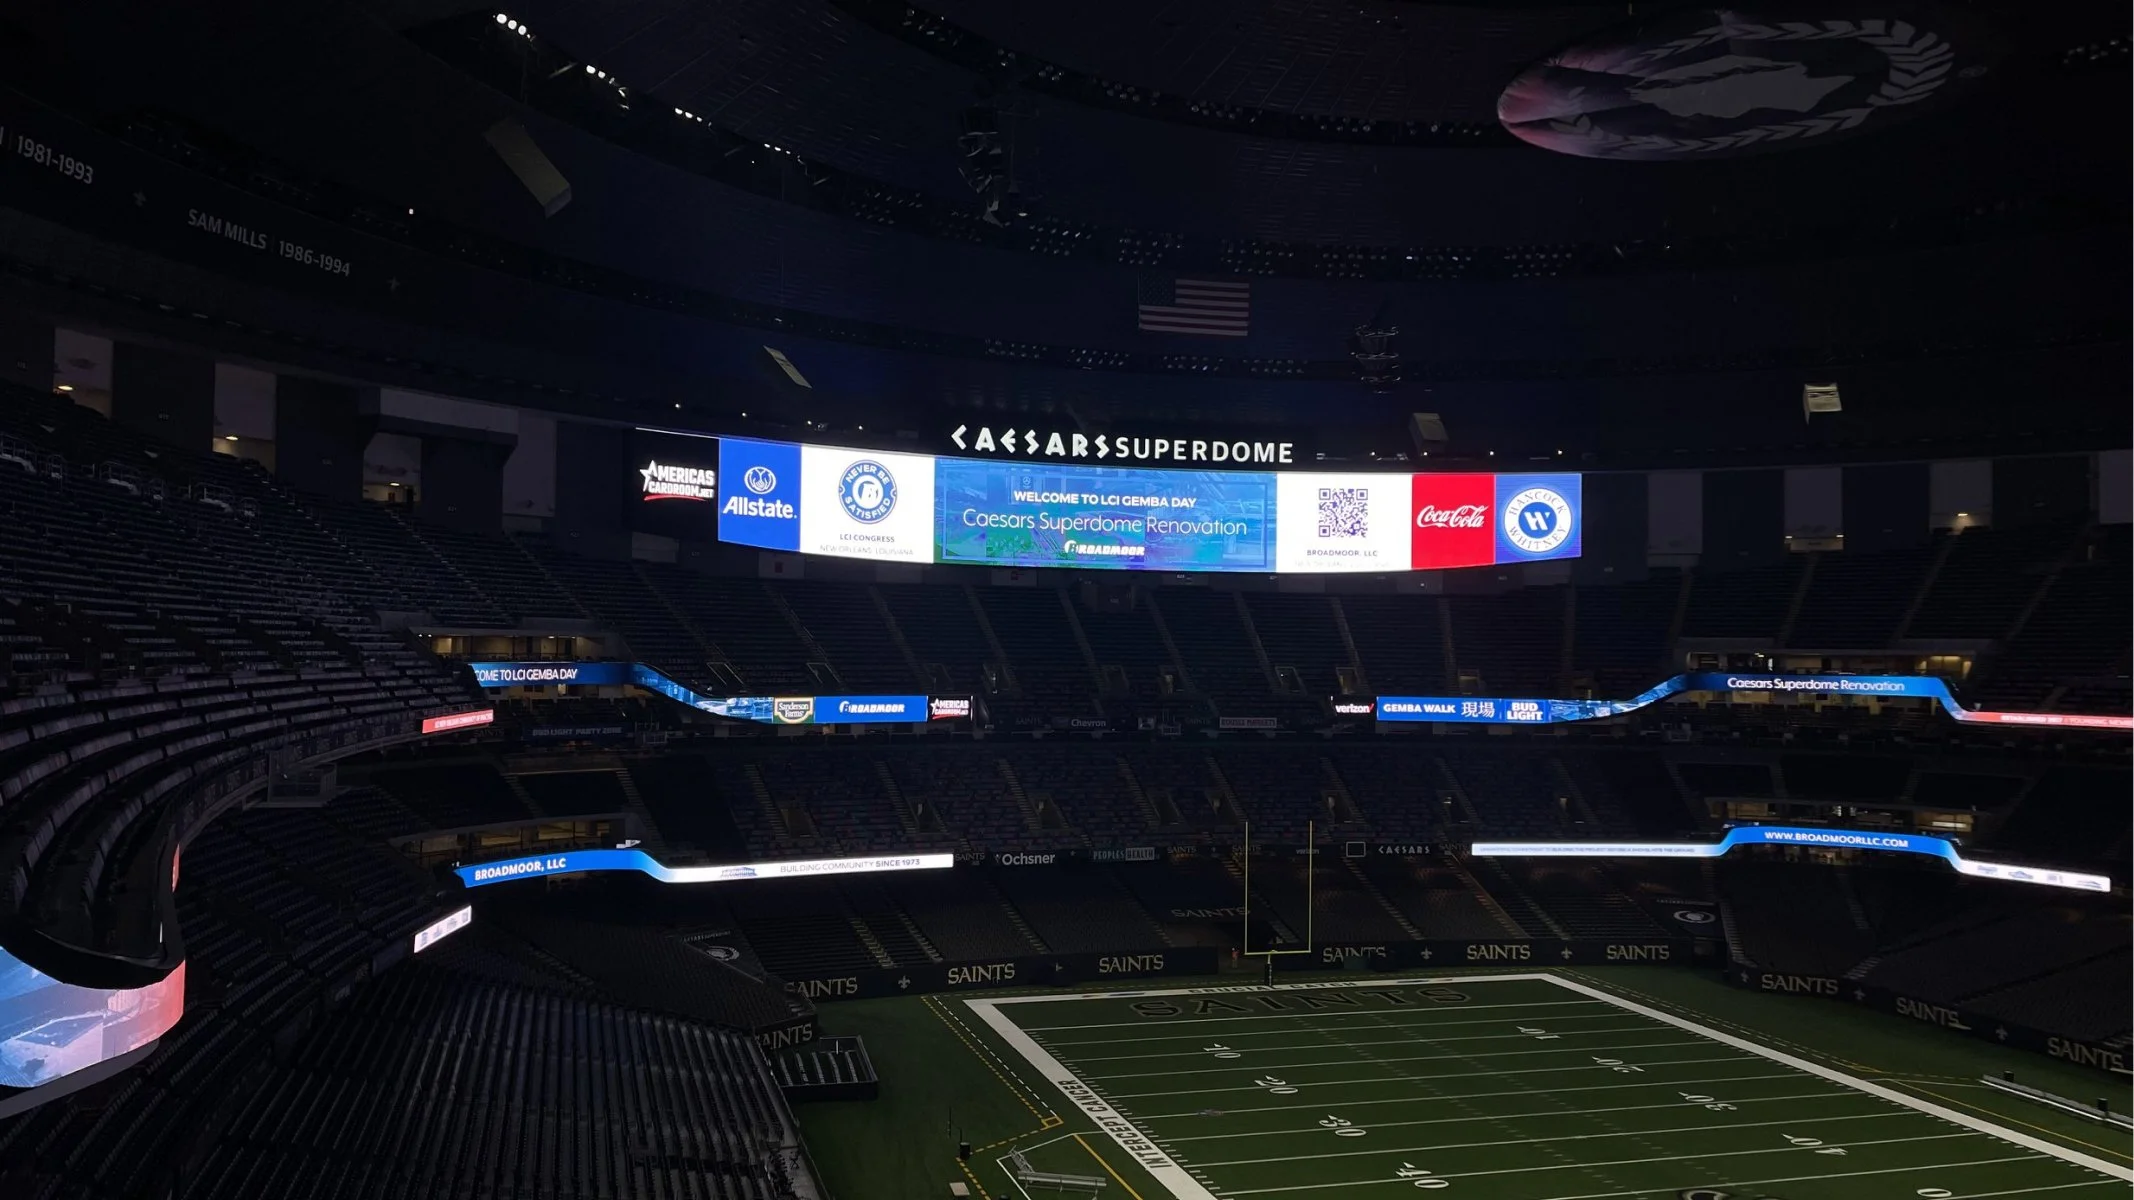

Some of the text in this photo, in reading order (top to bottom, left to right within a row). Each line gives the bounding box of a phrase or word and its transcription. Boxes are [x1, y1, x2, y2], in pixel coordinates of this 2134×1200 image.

[16, 134, 95, 186] 1981-1993
[187, 207, 352, 277] SAM MILLS 1986-1994
[951, 425, 1293, 463] CAESARS SUPERDOME
[640, 460, 715, 487] AMERICAS
[845, 464, 890, 485] NEVER BE
[845, 496, 891, 520] SATISFIED
[1013, 489, 1197, 509] WELCOME TO LCI GEMBA DAY
[1508, 491, 1567, 516] HANCOCK
[962, 508, 1247, 535] Caesars Superdome Renovation
[1416, 504, 1489, 528] Coca-Cola
[853, 534, 895, 543] CONGRESS
[1509, 526, 1568, 550] WHITNEY
[500, 669, 512, 681] TO
[512, 668, 526, 680] LCI
[526, 668, 558, 680] GEMBA
[560, 668, 578, 679] DAY
[1727, 677, 1905, 692] Caesars Superdome Renovation
[778, 702, 809, 711] Sanderson
[784, 710, 804, 718] Farms
[930, 698, 970, 710] AMERICAS
[1335, 704, 1370, 713] verizon
[1383, 704, 1456, 713] GEMBA WALK
[1461, 702, 1495, 718] 現場
[1511, 702, 1538, 711] BUD
[1507, 710, 1543, 720] LIGHT
[1764, 831, 1909, 848] WWW.BROADMOORLLC.COM
[475, 858, 567, 880] BROADMOOR, LLC
[780, 858, 921, 873] BUILDING COMMUNITY SINCE 1973
[1001, 852, 1056, 866] Ochsner
[1466, 944, 1531, 961] SAINTS
[1606, 944, 1671, 961] SAINTS
[946, 963, 1016, 985] SAINTS
[1098, 954, 1164, 974] SAINTS
[1189, 981, 1358, 994] CRUCIAL CATCH
[1760, 973, 1840, 996] SAINTS
[1128, 986, 1472, 1019] SAINTS
[1896, 997, 1961, 1026] SAINTS
[2047, 1036, 2125, 1071] SAINTS
[1058, 1079, 1173, 1169] INTERCEPT CANCER
